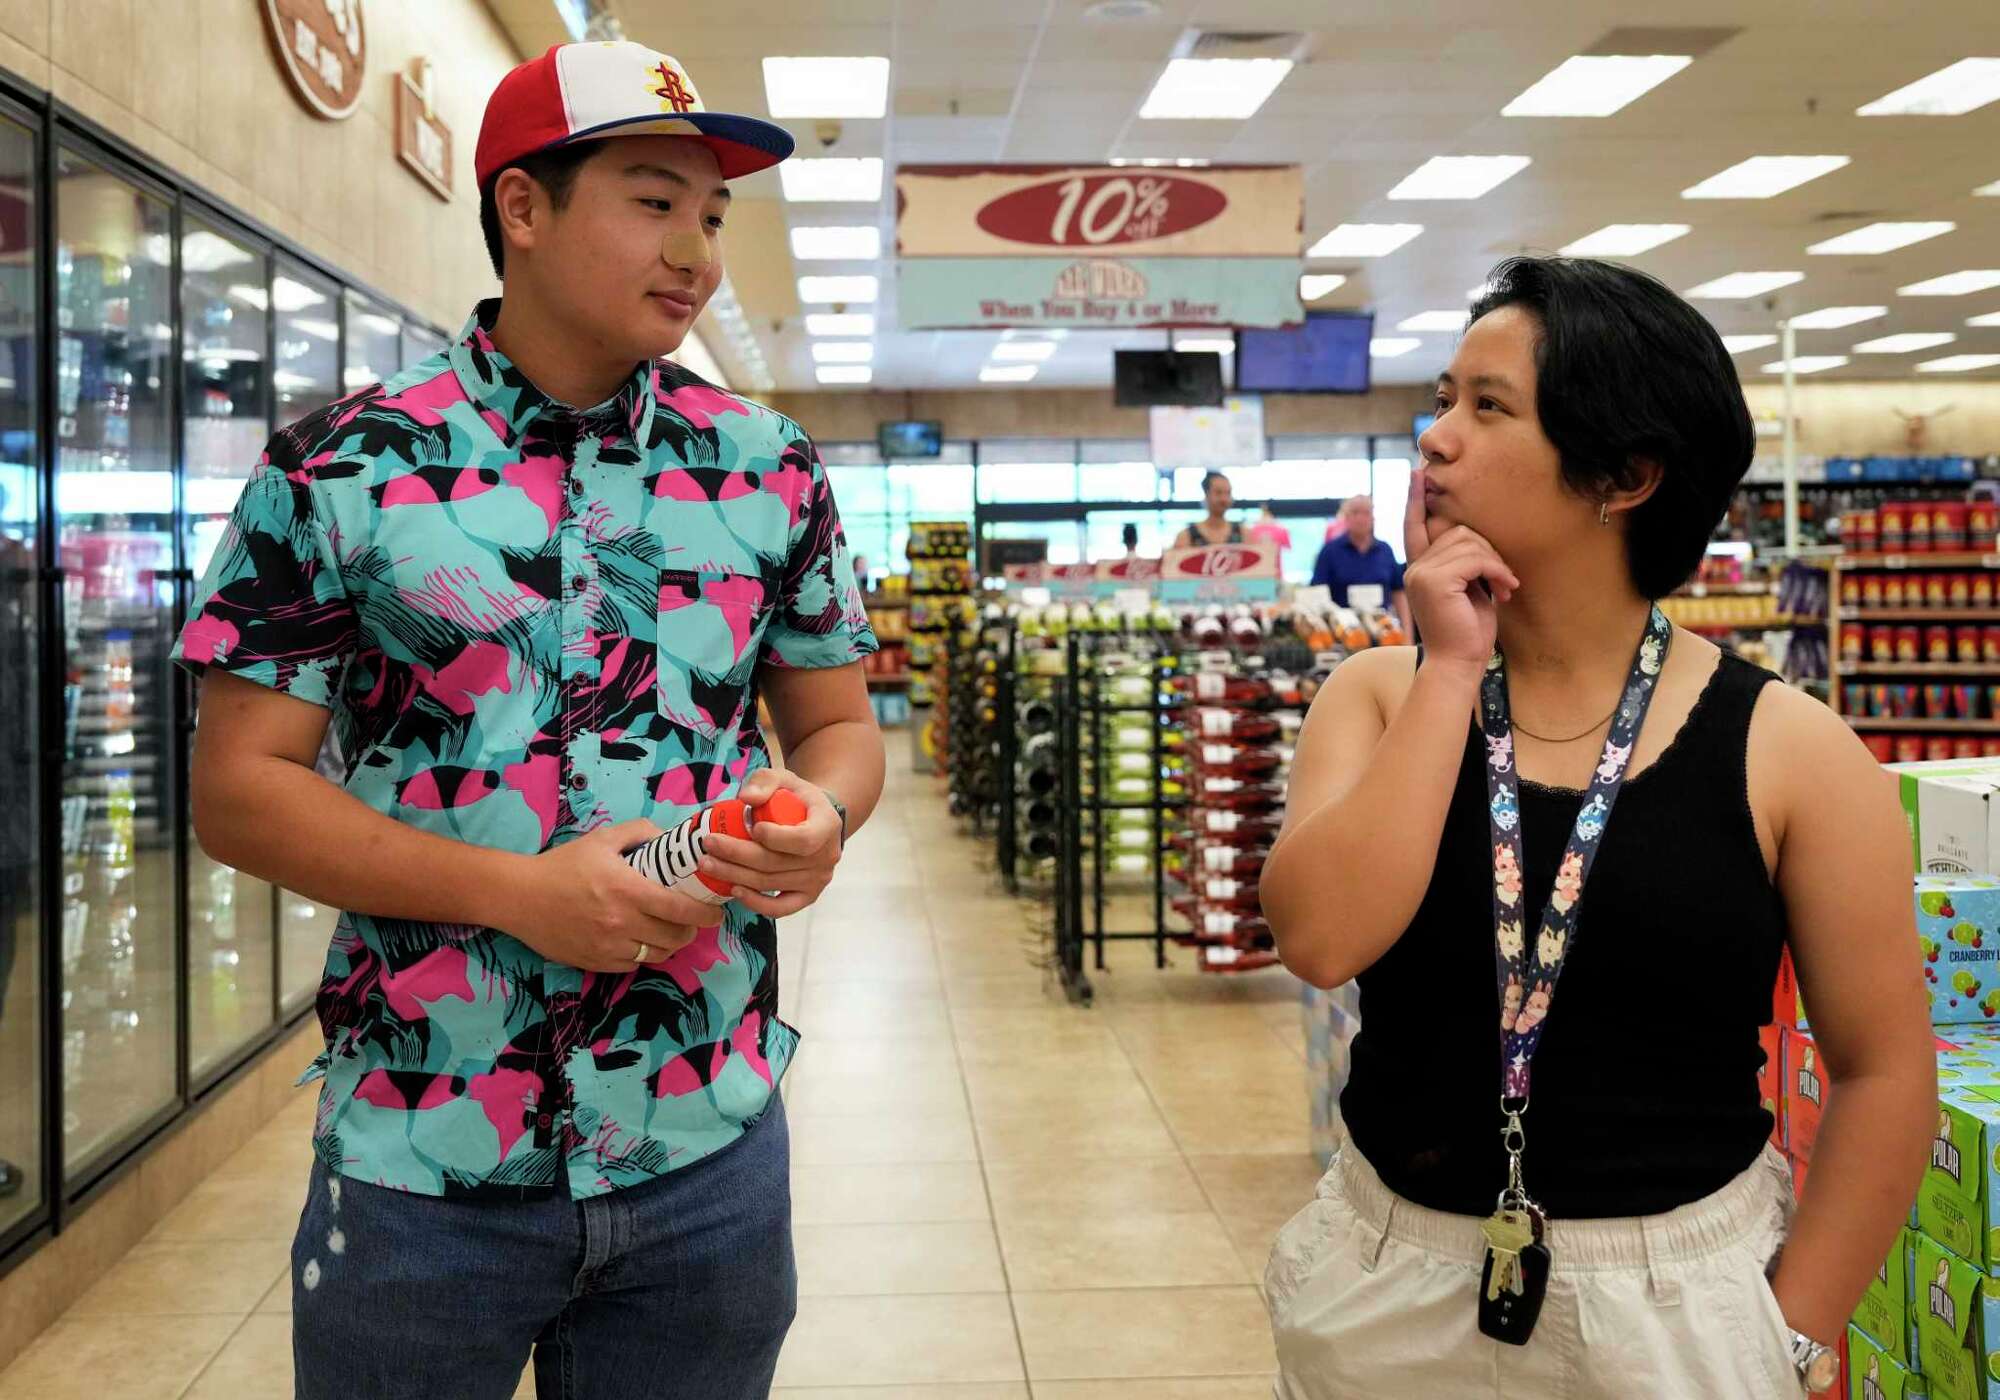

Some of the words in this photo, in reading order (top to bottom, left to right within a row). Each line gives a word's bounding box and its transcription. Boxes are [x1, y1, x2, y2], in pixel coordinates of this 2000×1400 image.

[1051, 178, 1171, 243] 10%
[1124, 218, 1161, 241] off
[980, 300, 1034, 318] When
[1041, 300, 1077, 318] You
[1083, 300, 1118, 321] Buy
[1128, 302, 1138, 317] 4
[1143, 304, 1162, 318] or
[1169, 300, 1220, 318] More
[624, 808, 713, 887] PRIM
[1949, 949, 1996, 963] CRANBERRY
[1799, 1071, 1819, 1105] POLAR
[1933, 1139, 1959, 1180] POLAR
[1930, 1285, 1955, 1329] POLAR
[1863, 1379, 1885, 1400] POL
